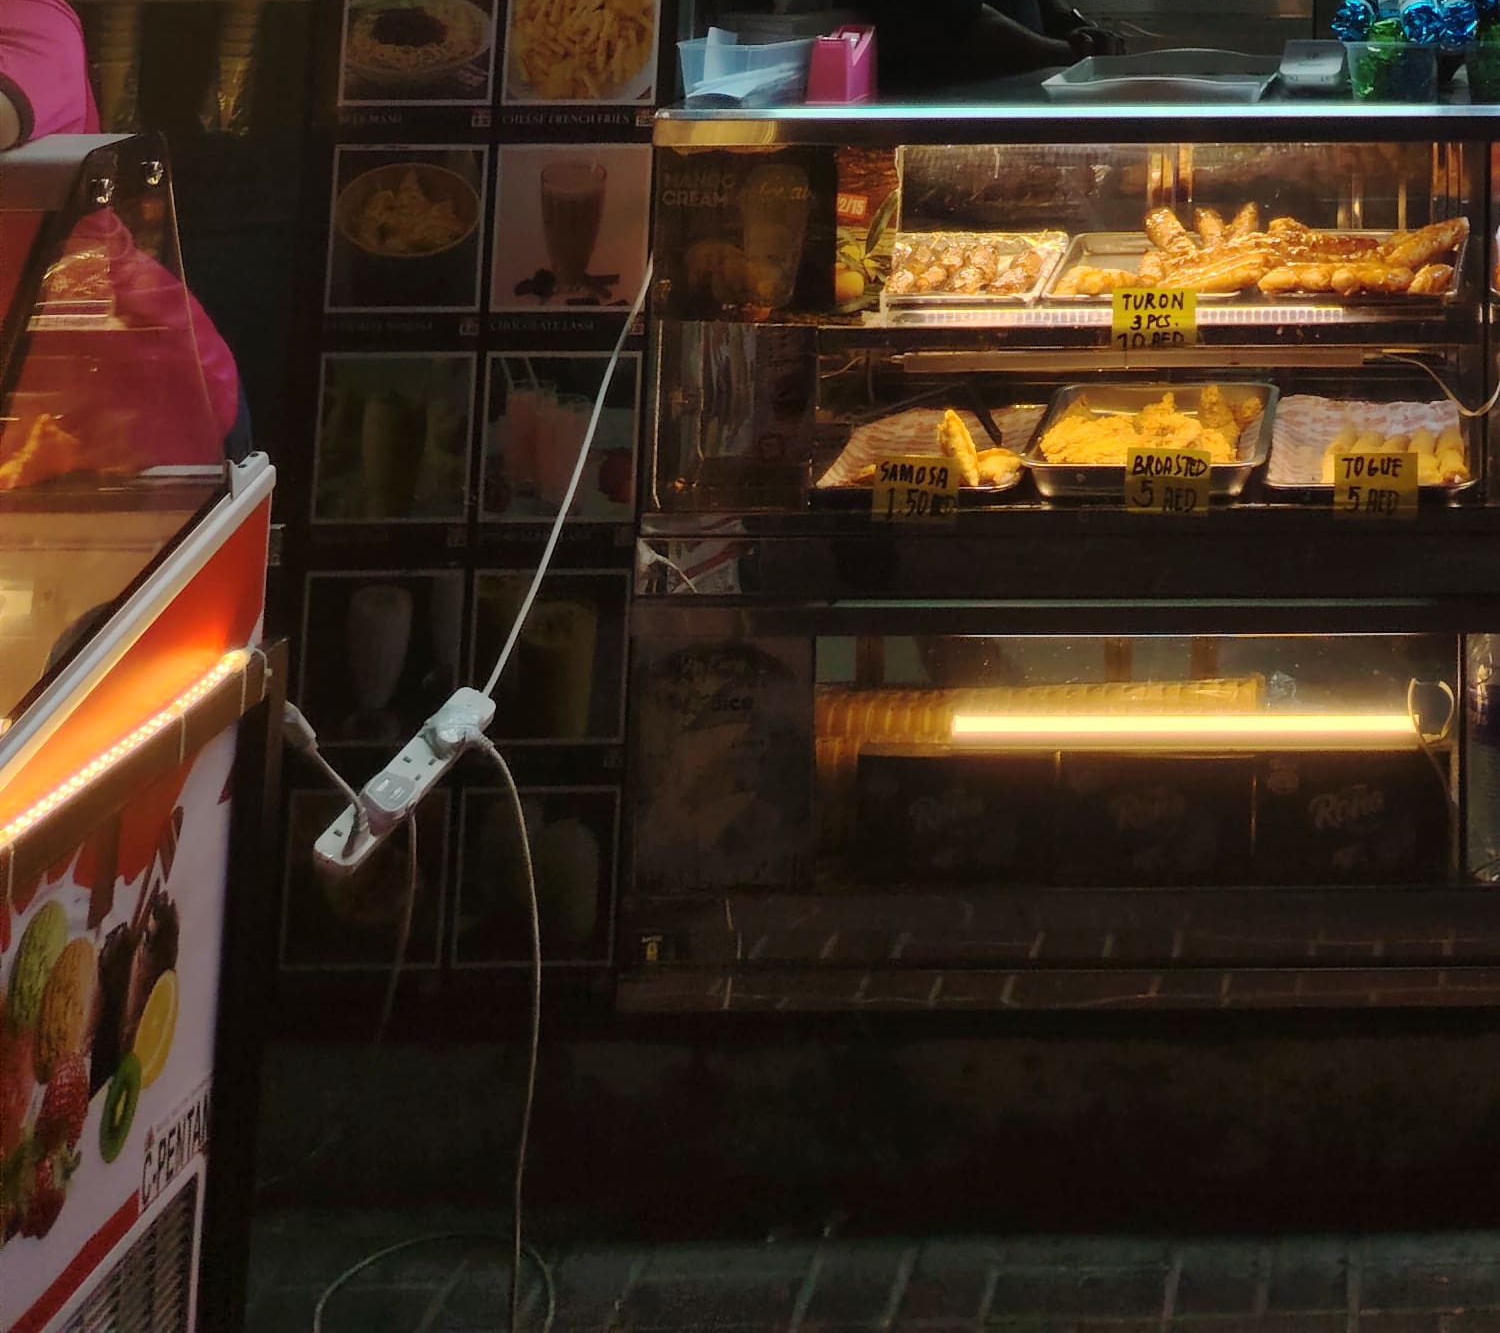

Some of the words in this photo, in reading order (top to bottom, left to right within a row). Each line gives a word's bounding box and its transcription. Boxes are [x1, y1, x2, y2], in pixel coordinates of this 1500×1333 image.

[1122, 291, 1185, 311] TURON
[1130, 314, 1141, 331] 3
[880, 461, 949, 490] SAMOSA
[1132, 454, 1208, 477] BROASTED
[1132, 478, 1155, 507] 5
[1162, 485, 1198, 513] AED
